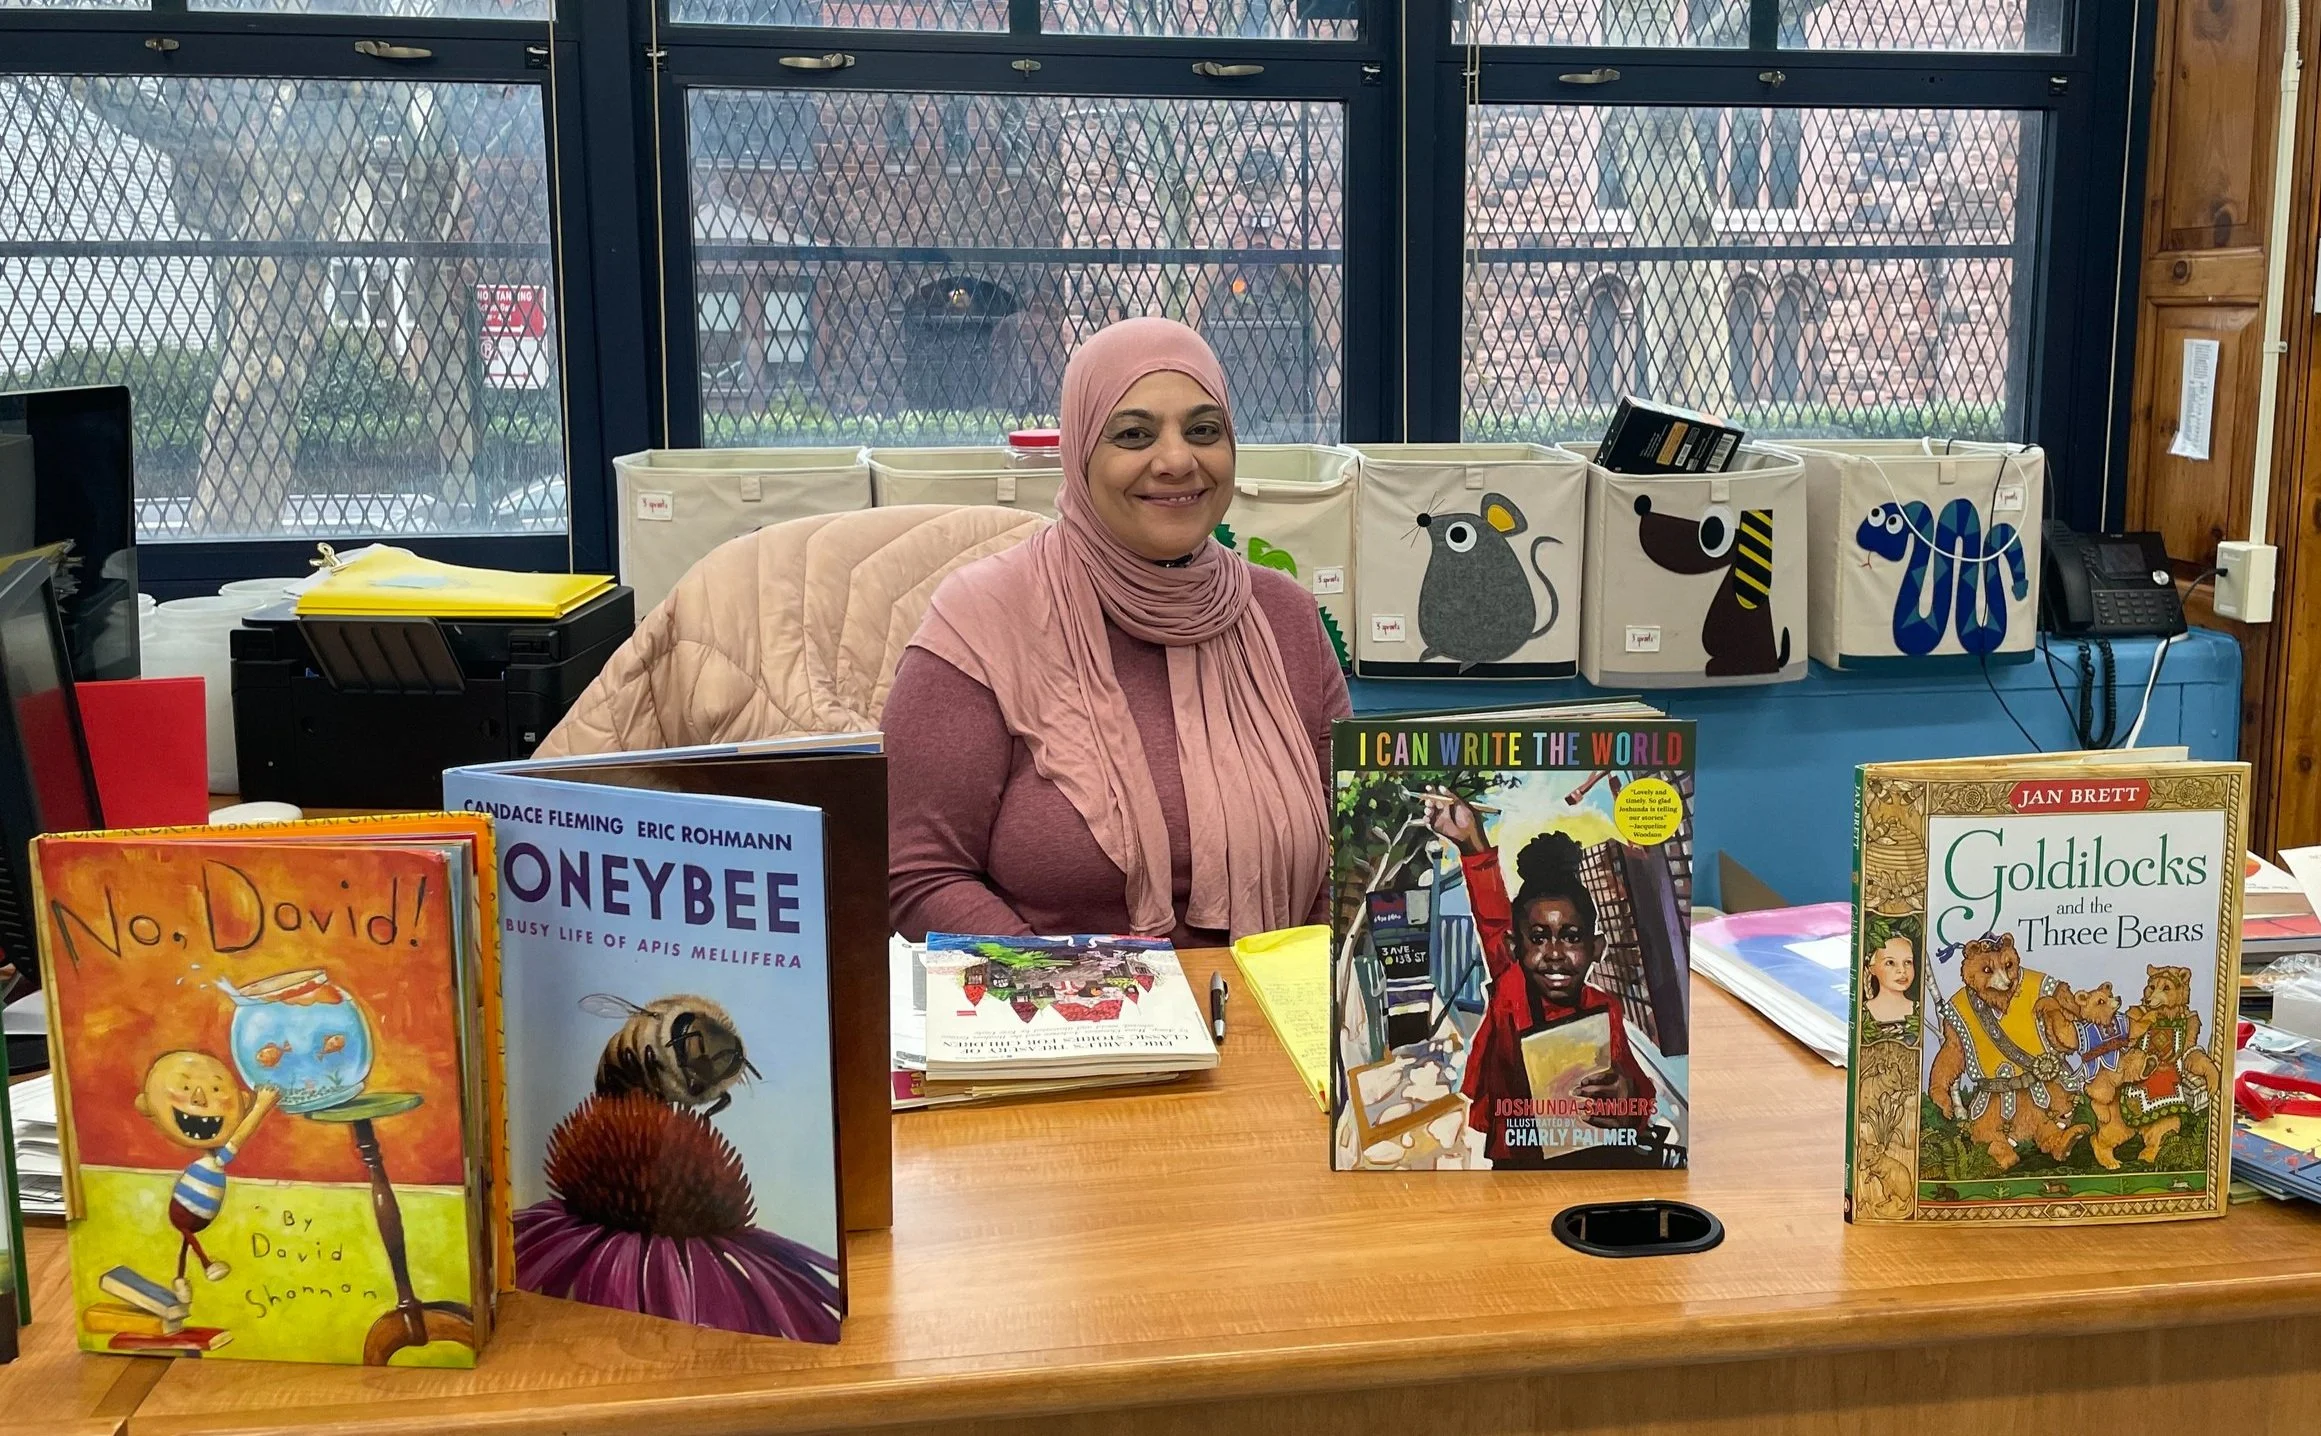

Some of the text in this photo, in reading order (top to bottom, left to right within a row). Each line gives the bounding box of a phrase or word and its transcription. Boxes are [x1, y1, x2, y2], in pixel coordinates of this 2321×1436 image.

[477, 291, 533, 302] NO TANING
[1360, 732, 1683, 766] I CAN WRITE THE WORLD
[2017, 786, 2140, 808] JAN BRETT
[464, 799, 543, 824] CANDACE
[549, 810, 623, 834] FLEMING
[638, 820, 675, 841] ERIC
[682, 825, 793, 851] ROHMANN
[503, 841, 801, 935] ONEYBEE
[1937, 827, 2207, 946] Goldilocks
[50, 858, 427, 976] No, David!
[2056, 896, 2113, 915] and the
[506, 918, 802, 969] BUSY LIFE OF APIS MELLIFERA
[2018, 915, 2204, 952] Three Bears
[1382, 945, 1414, 956] 3 AVE.
[1395, 953, 1412, 964] 138
[1494, 1097, 1659, 1117] JOSHUNDA SANDERS
[1506, 1118, 1577, 1128] ILLUSTRATED BY
[1505, 1128, 1638, 1147] CHARLY PALMER
[283, 1210, 313, 1233] By
[252, 1232, 343, 1263] David
[245, 1283, 378, 1319] Shannon
